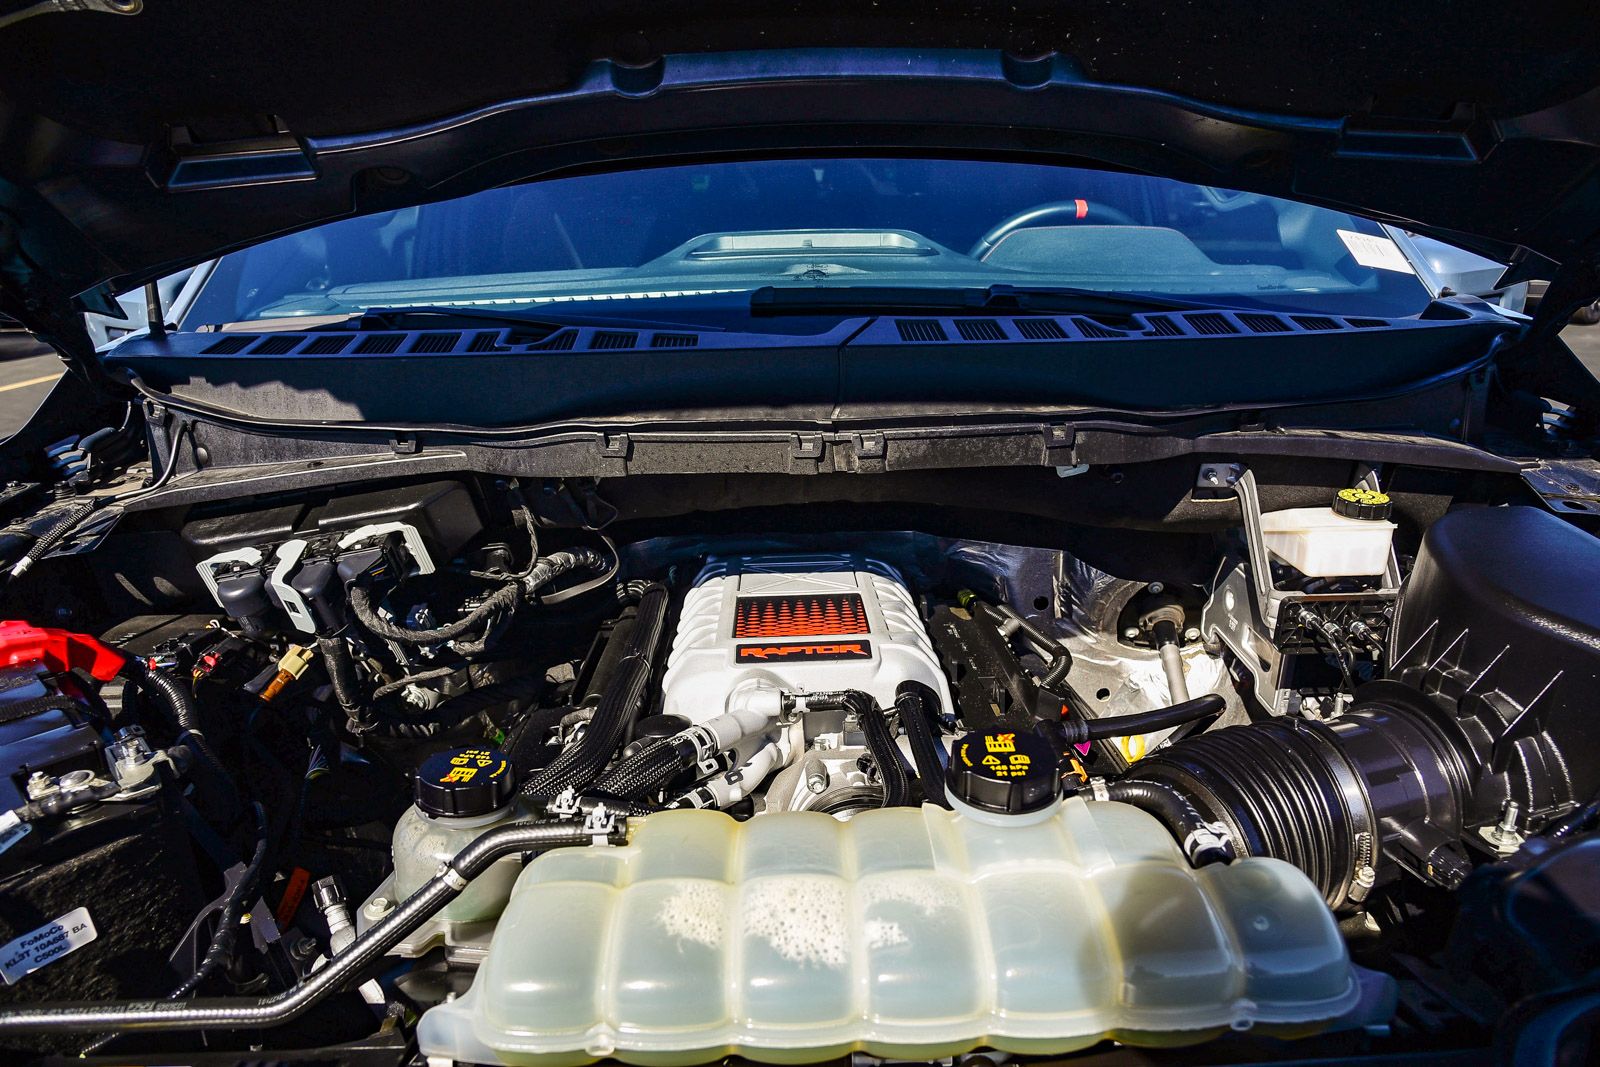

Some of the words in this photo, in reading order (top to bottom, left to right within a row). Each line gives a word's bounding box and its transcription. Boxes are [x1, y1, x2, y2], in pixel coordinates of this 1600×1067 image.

[740, 644, 869, 659] RAPTOR
[72, 923, 88, 934] BA
[19, 925, 64, 949] FoMoCo
